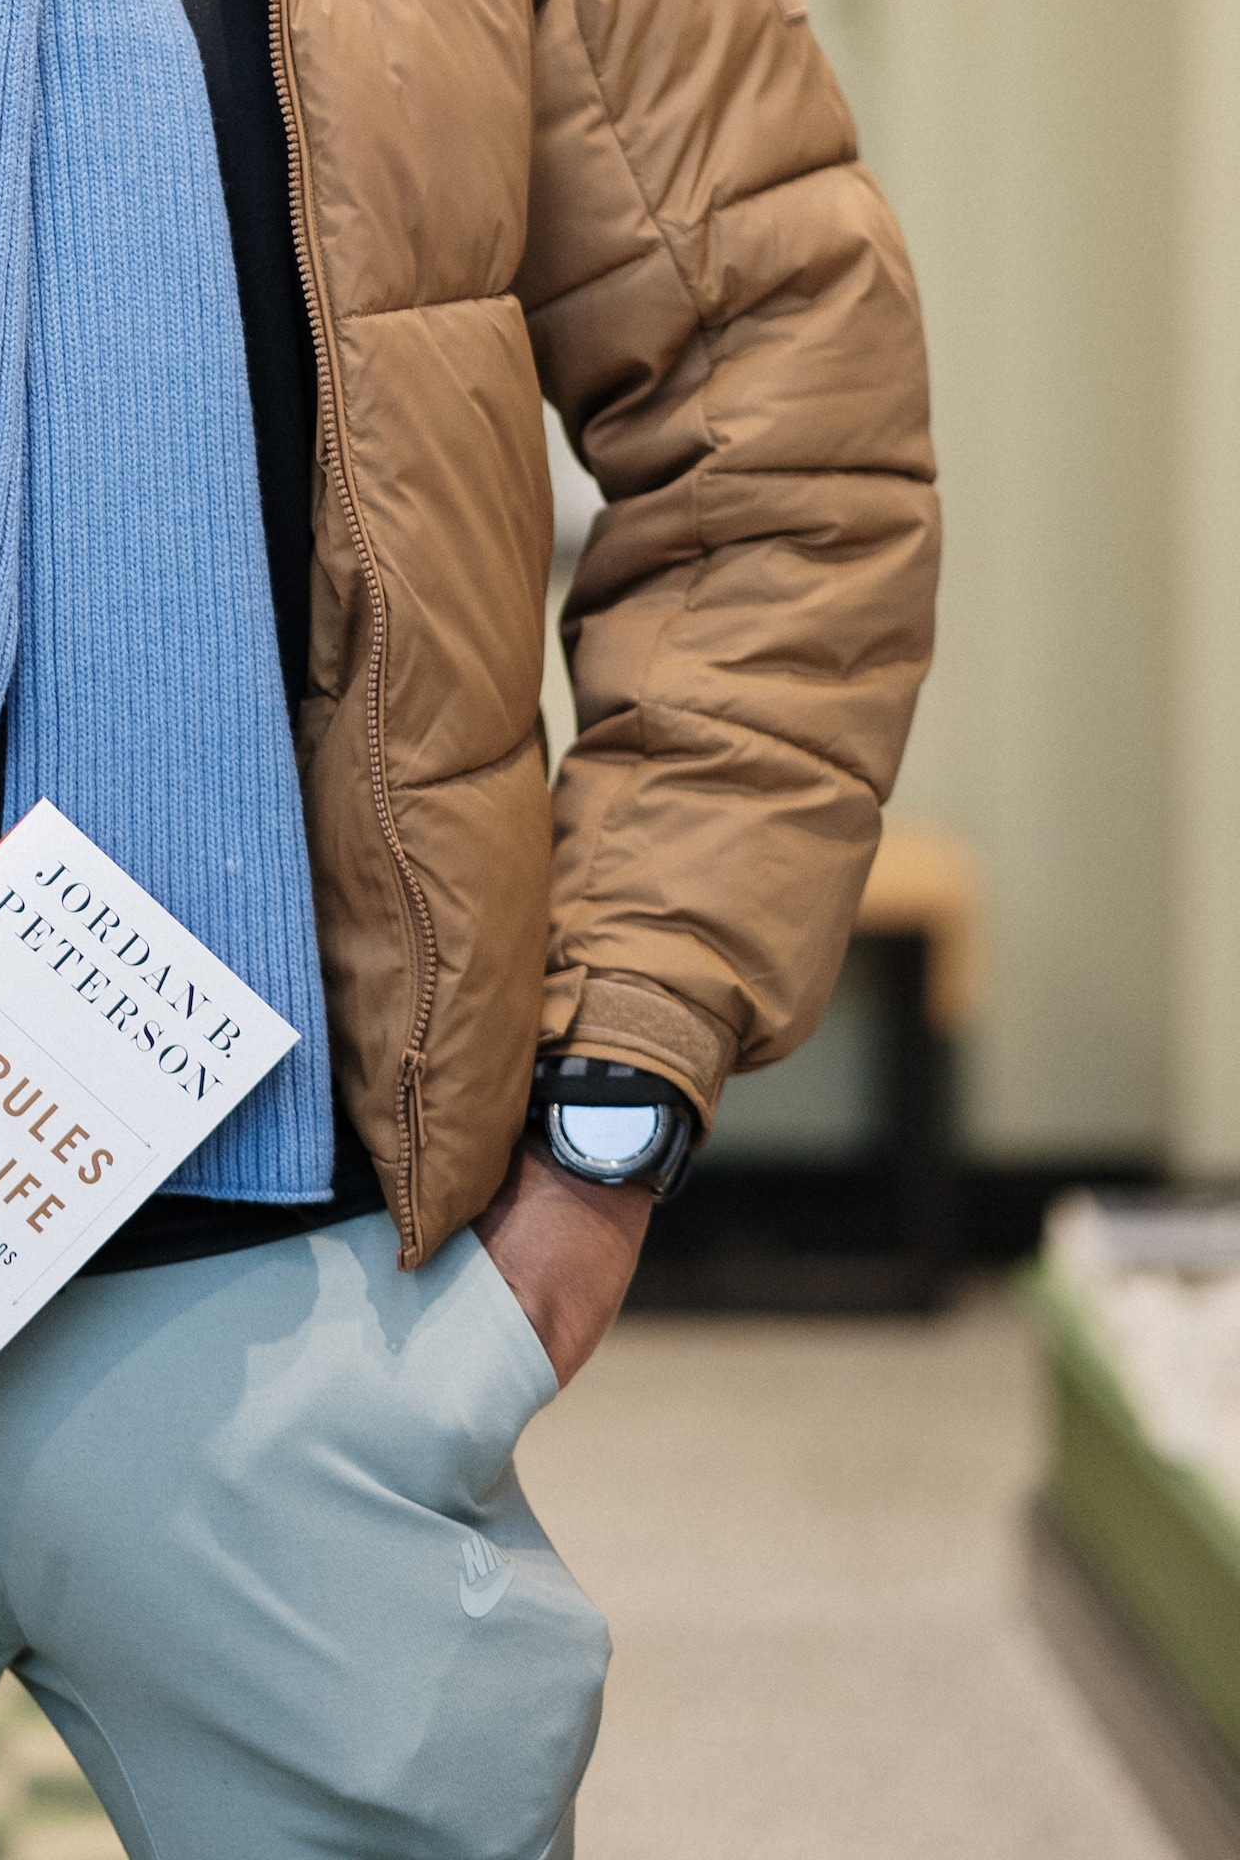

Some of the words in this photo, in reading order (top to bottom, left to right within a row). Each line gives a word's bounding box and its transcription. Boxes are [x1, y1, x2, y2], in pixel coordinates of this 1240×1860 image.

[34, 859, 212, 1020] JORDAN
[202, 1012, 241, 1058] B.
[460, 1533, 510, 1586] NIK
